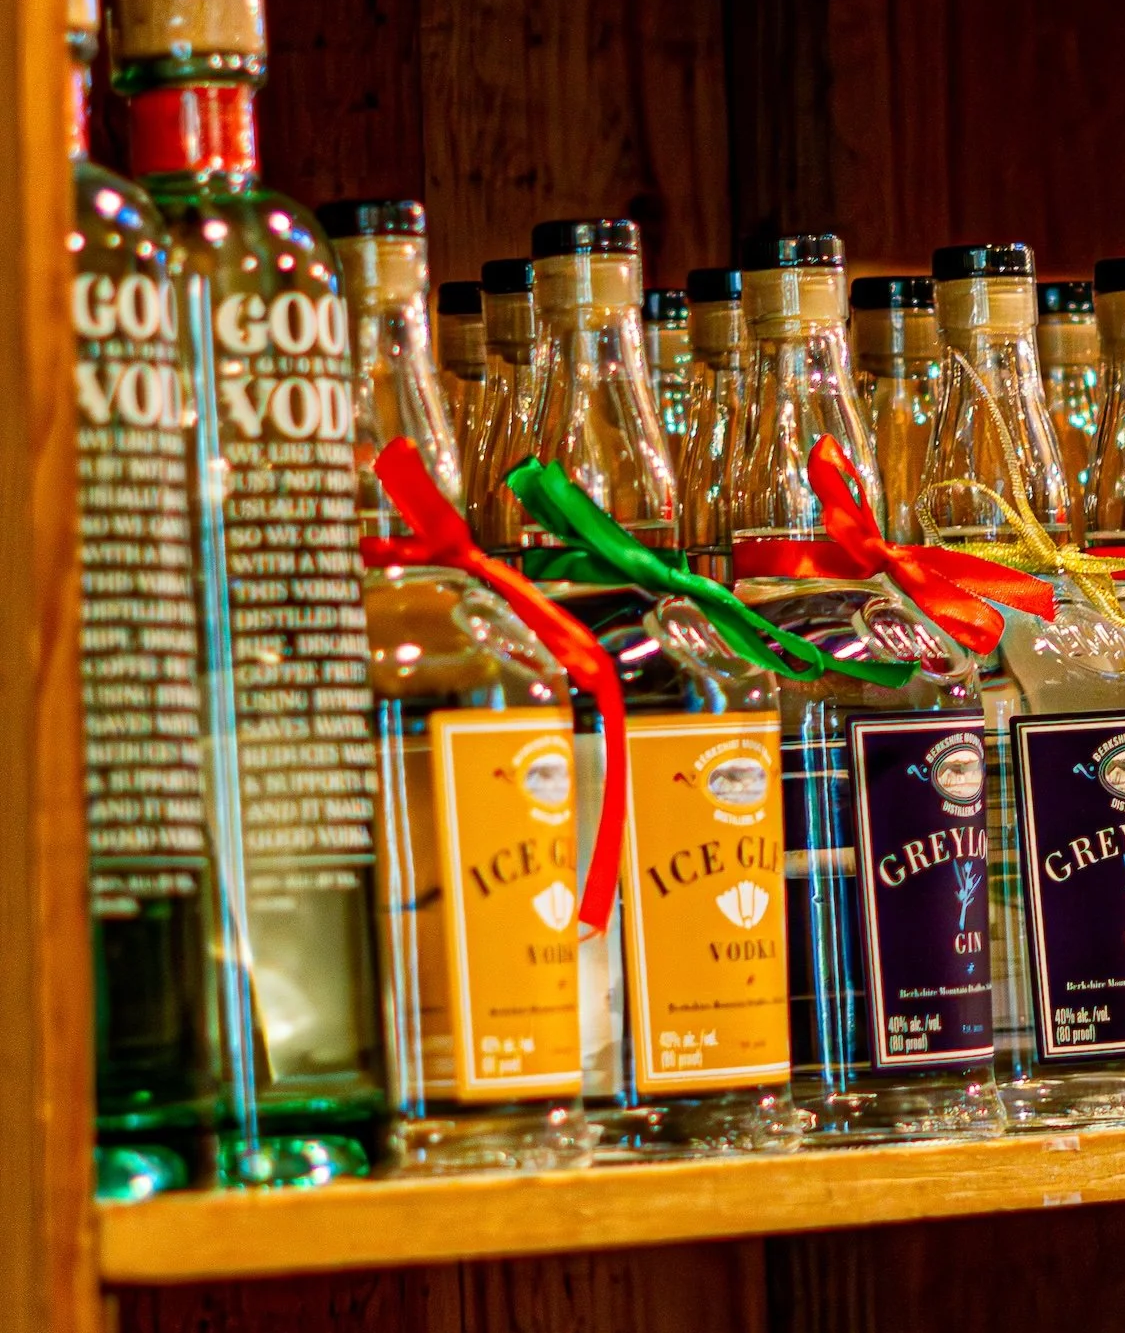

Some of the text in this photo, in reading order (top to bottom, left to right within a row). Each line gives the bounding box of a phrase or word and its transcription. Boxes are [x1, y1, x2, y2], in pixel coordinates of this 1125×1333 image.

[879, 826, 988, 887] GREYLO
[469, 838, 537, 899] ICE
[647, 840, 725, 898] ICE
[955, 931, 982, 955] GIN
[1066, 980, 1106, 991] Berkshire
[888, 1014, 924, 1034] 40% alc.
[1055, 1008, 1075, 1025] 40%
[1077, 1006, 1092, 1023] alc.
[889, 1033, 929, 1054] (80 proof)
[1056, 1024, 1096, 1045] (80 proof)
